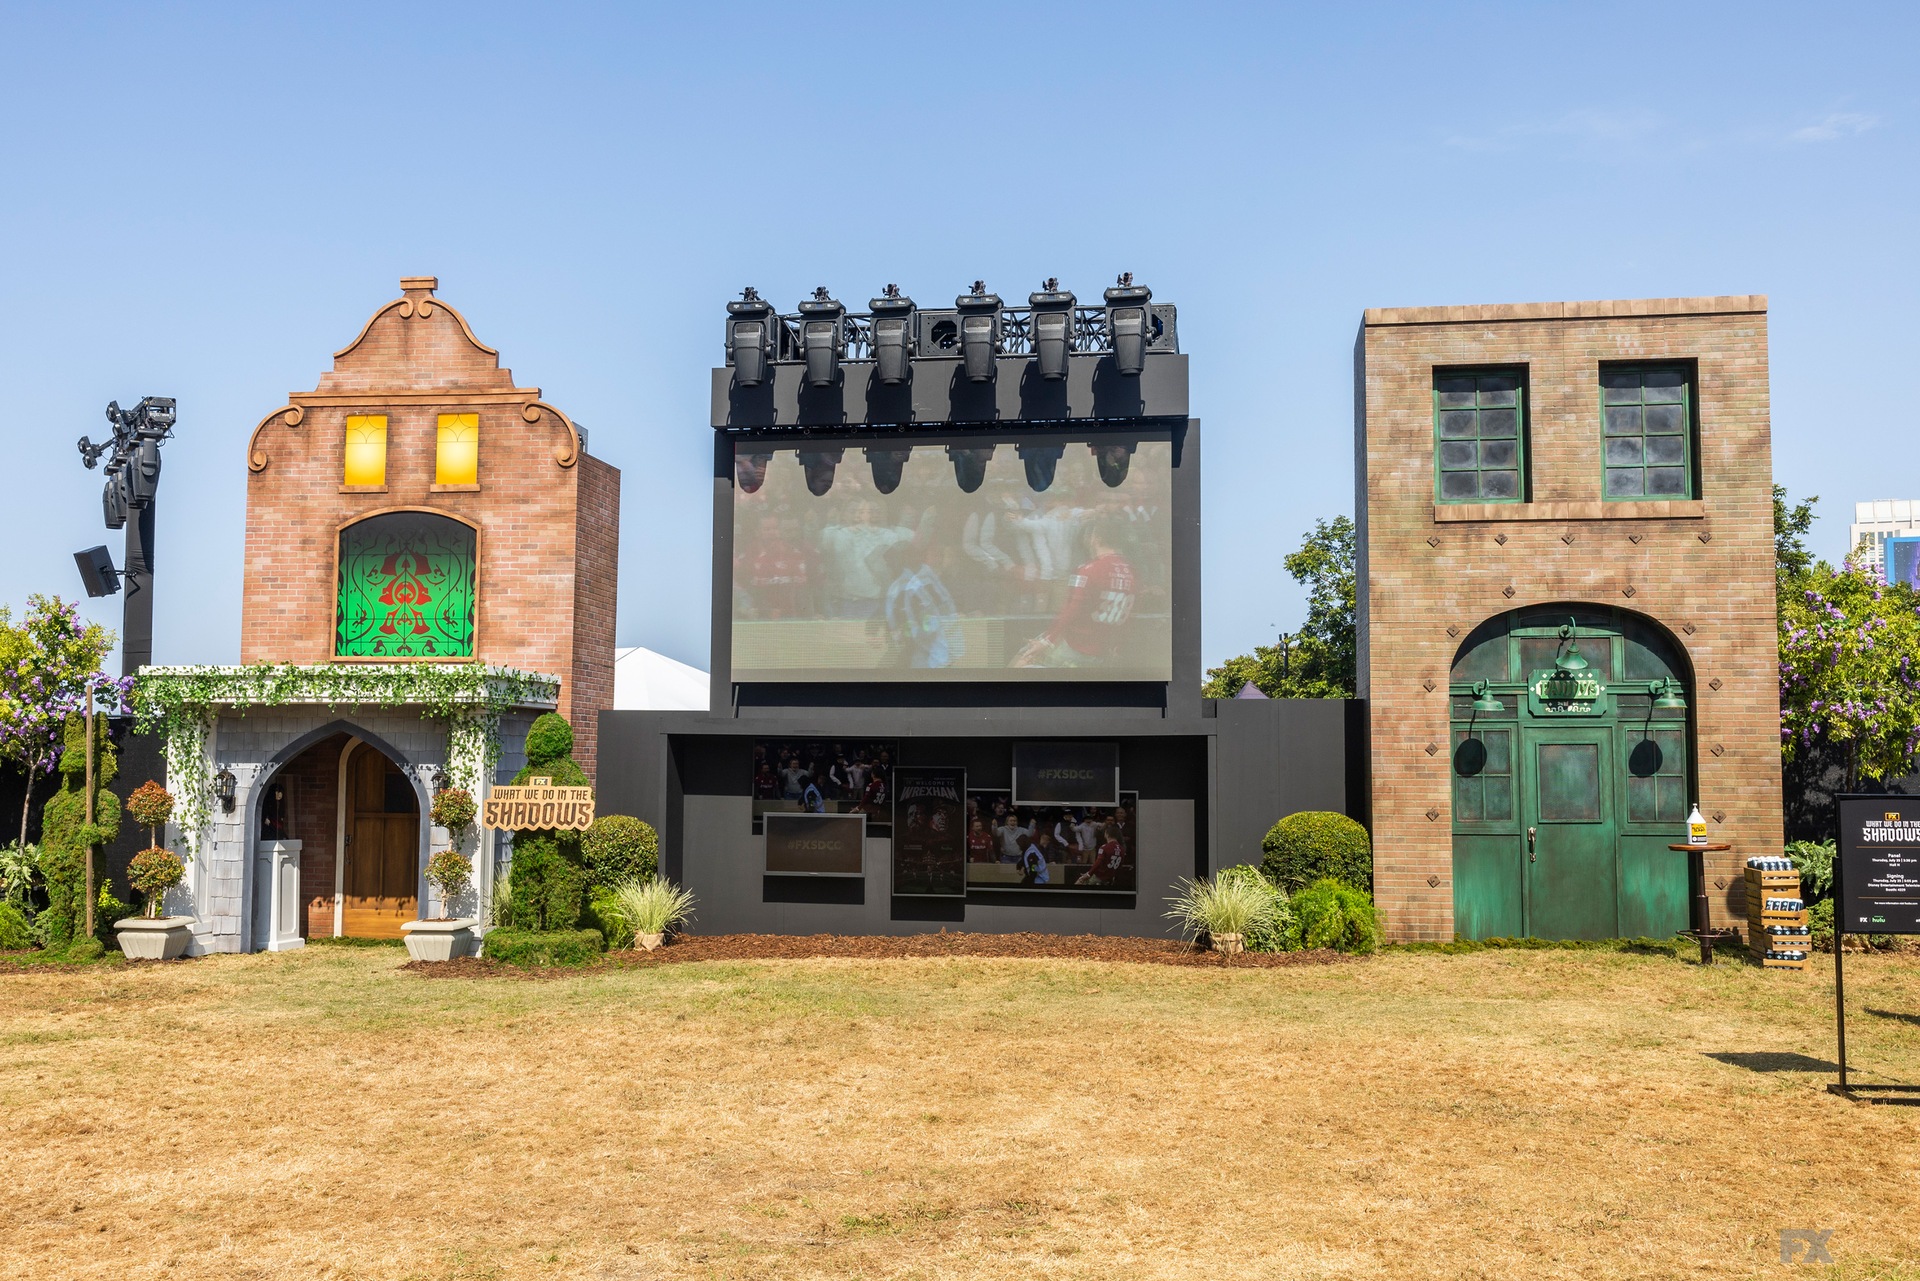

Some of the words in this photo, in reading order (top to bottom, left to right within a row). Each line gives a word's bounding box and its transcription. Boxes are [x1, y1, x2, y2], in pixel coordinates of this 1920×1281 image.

[1038, 768, 1094, 780] #FXSDCC
[494, 789, 521, 800] WHAT
[524, 789, 539, 800] WE
[542, 789, 554, 800] DO
[558, 789, 567, 800] IN
[571, 789, 588, 800] THE
[900, 786, 960, 802] WREXHAM
[486, 802, 591, 827] SHADOWS
[788, 840, 841, 850] #FXSDCC
